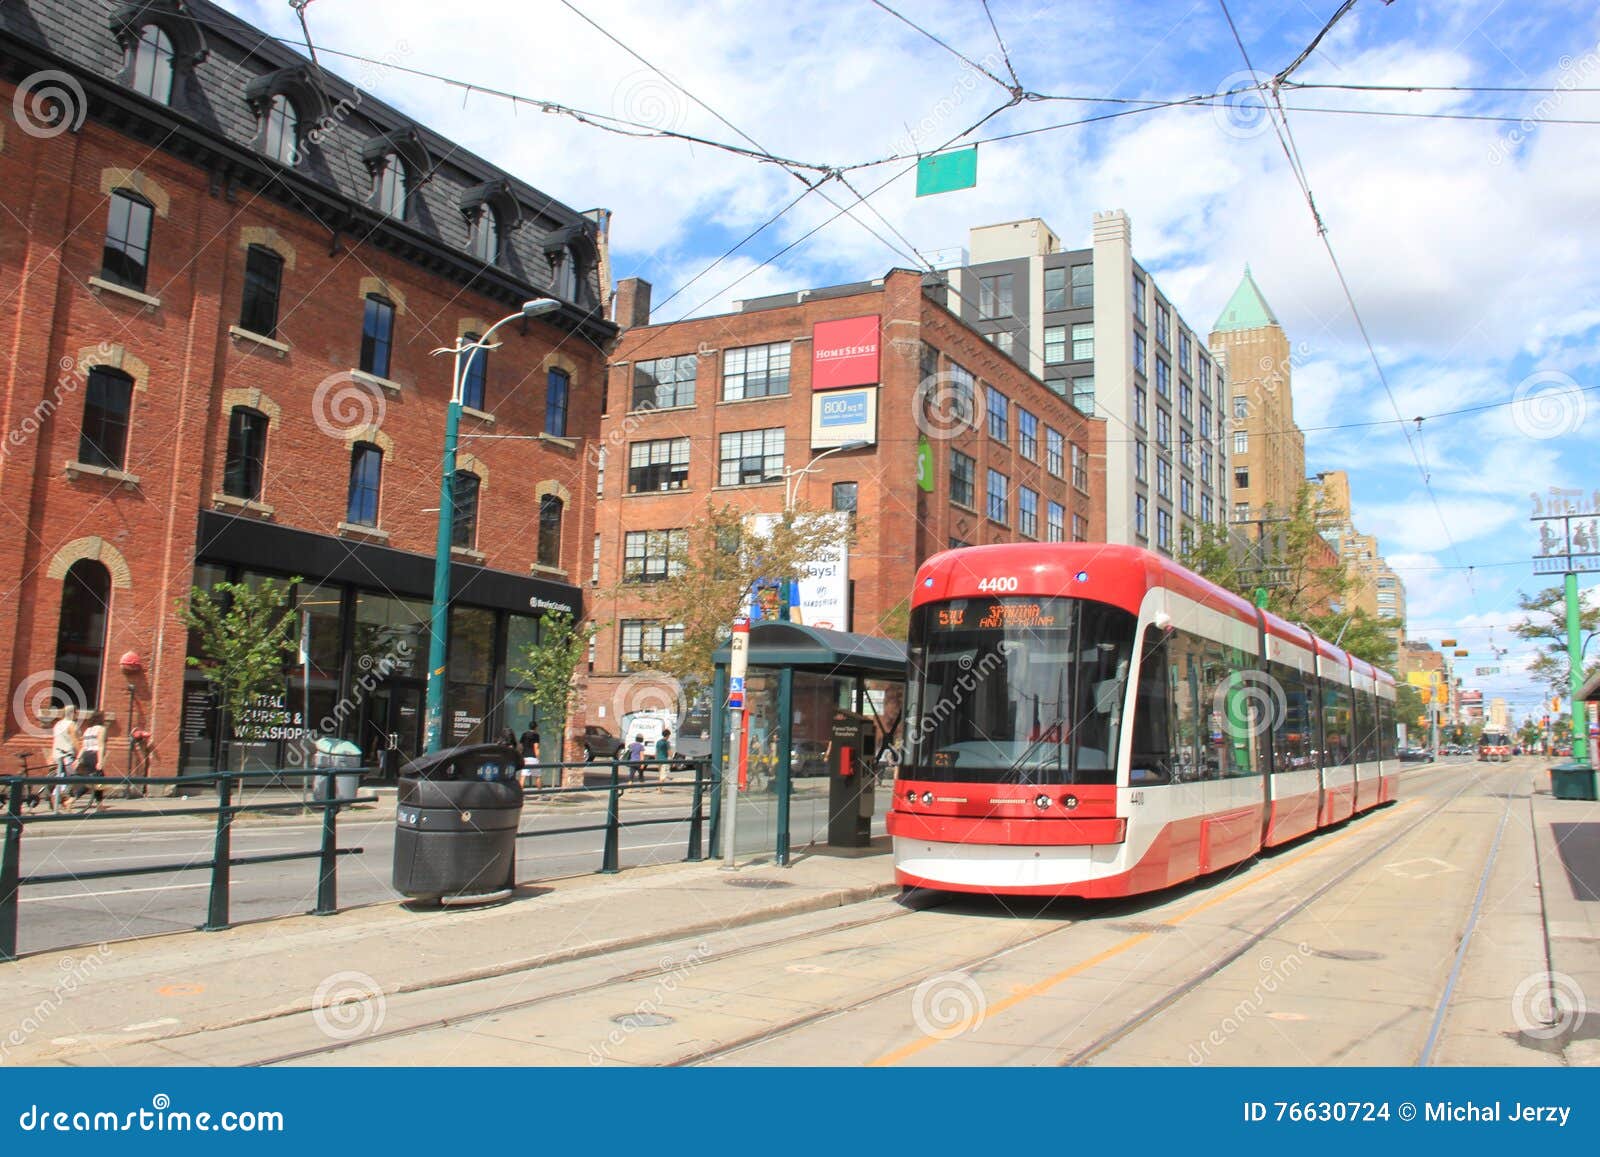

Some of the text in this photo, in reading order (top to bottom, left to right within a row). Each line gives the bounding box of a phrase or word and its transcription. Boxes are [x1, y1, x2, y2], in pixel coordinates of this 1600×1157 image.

[824, 400, 847, 414] 800
[978, 576, 1018, 591] 4400
[294, 712, 303, 725] &
